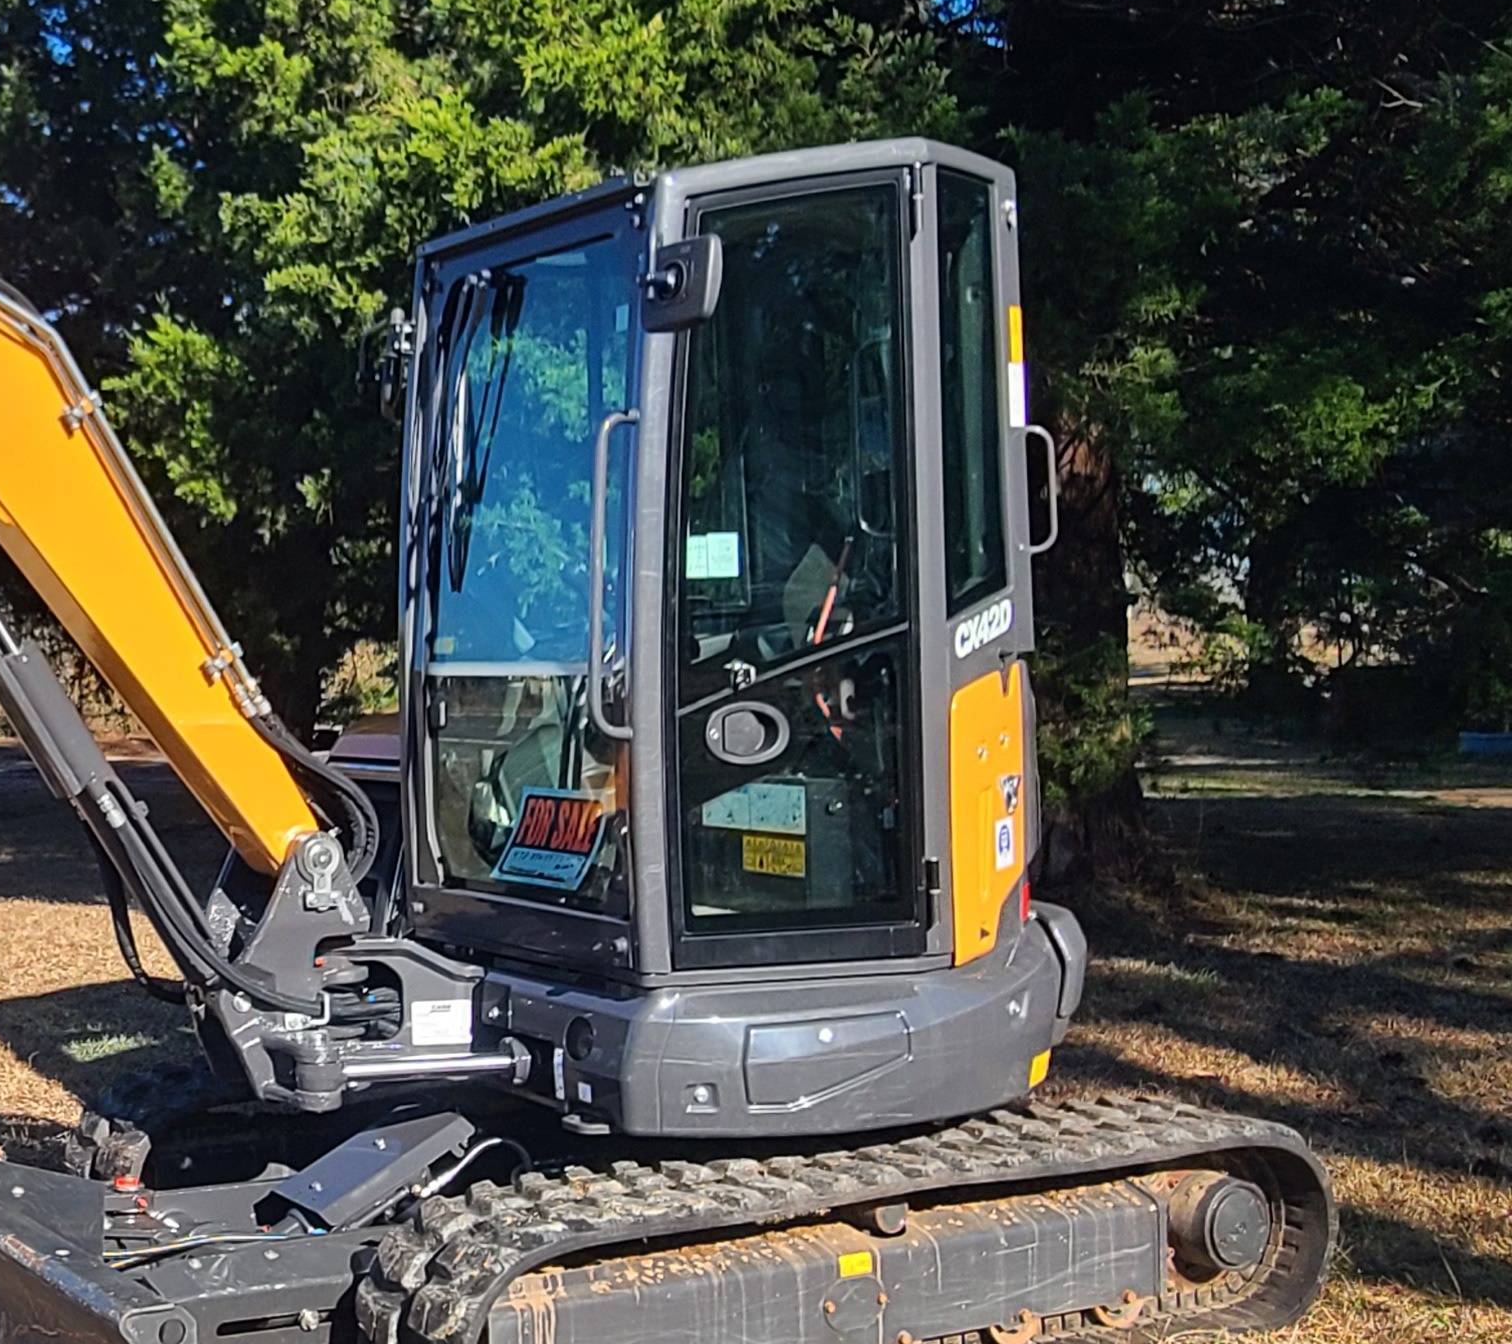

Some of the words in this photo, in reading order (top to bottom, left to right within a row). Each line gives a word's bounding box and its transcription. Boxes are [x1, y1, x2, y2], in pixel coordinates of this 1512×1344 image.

[954, 598, 1013, 659] CX42D
[515, 797, 555, 848] FOR
[548, 799, 602, 854] SALE
